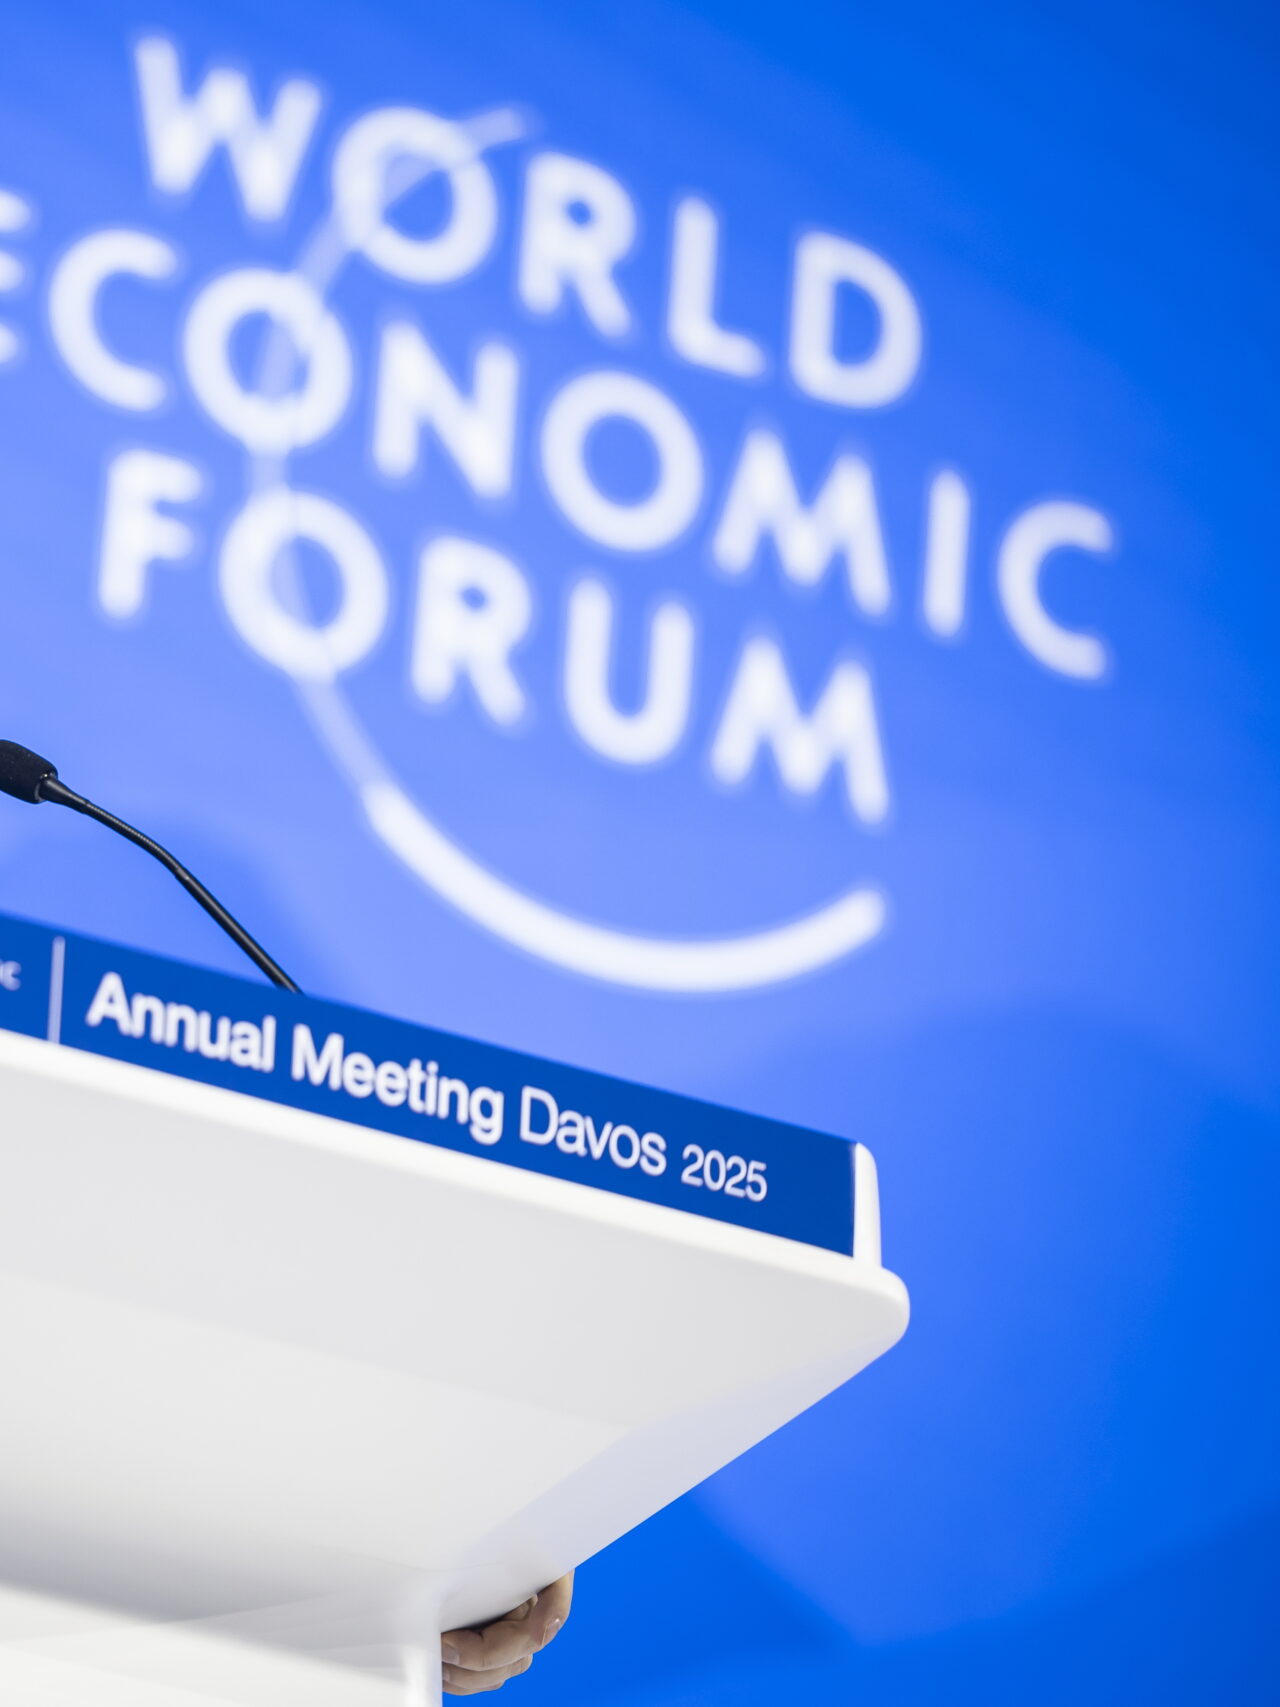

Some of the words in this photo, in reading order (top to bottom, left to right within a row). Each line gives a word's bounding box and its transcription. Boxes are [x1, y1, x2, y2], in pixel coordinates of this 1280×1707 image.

[136, 35, 923, 410] WORLD
[96, 449, 890, 826] FORUM
[86, 972, 276, 1073] Annual
[291, 1025, 505, 1146] Meeting
[519, 1085, 668, 1177] Davos
[680, 1144, 768, 1202] 2025
